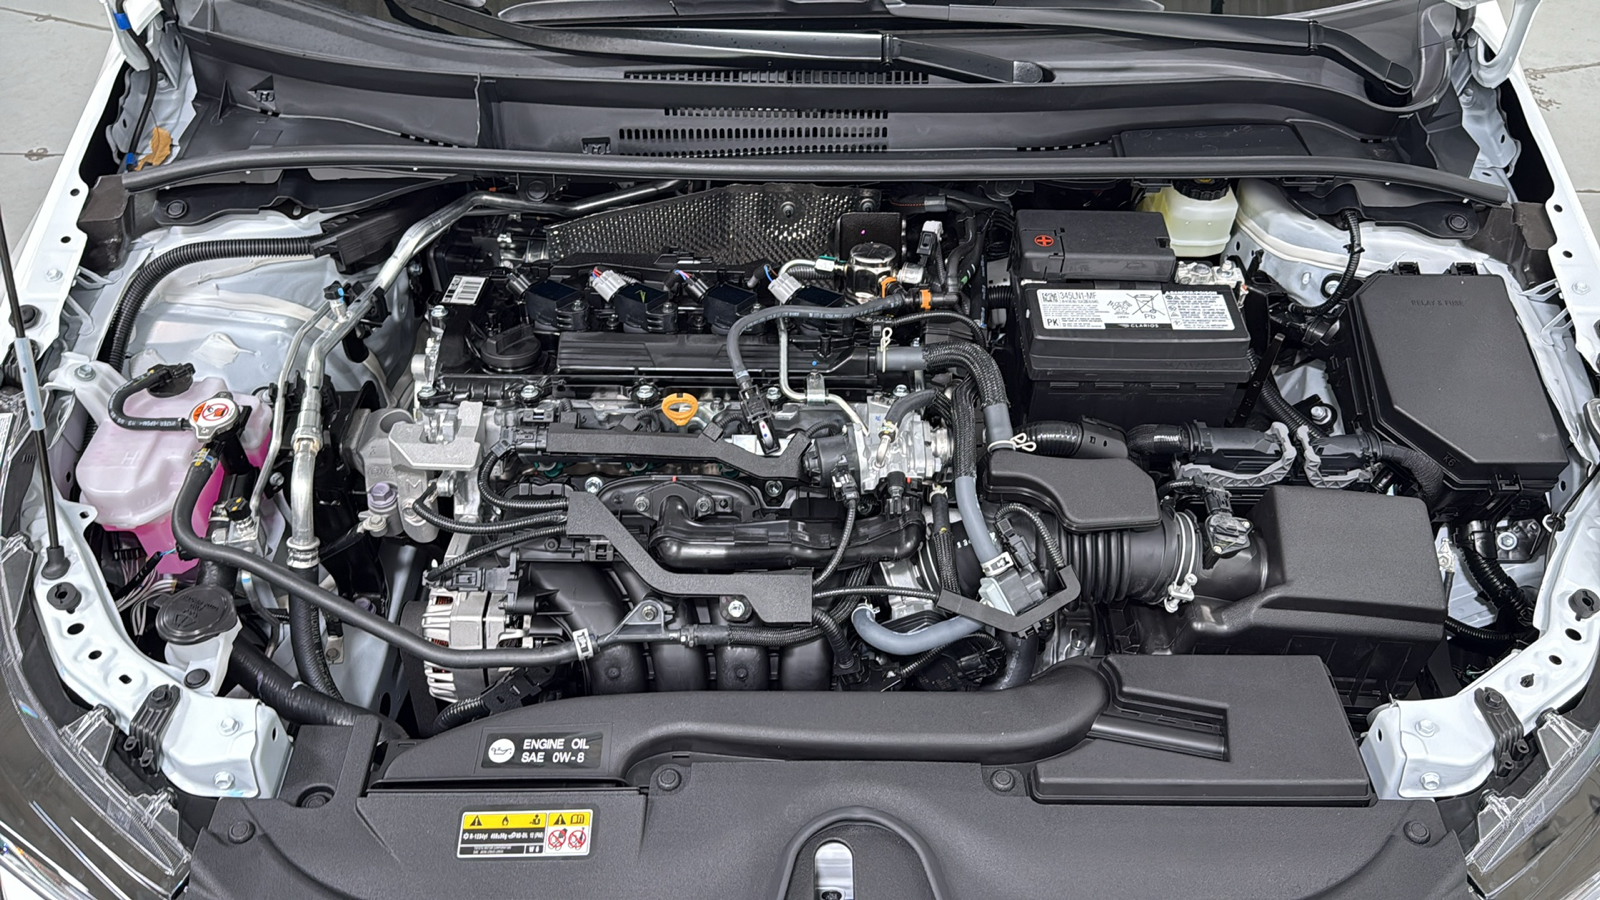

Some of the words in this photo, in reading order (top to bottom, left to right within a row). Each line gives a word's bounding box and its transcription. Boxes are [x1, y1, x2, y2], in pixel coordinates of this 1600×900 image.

[1047, 318, 1059, 327] PK
[523, 738, 565, 750] ENGINE
[571, 738, 590, 749] OIL
[521, 752, 545, 763] SAE
[552, 752, 585, 763] 0W-8
